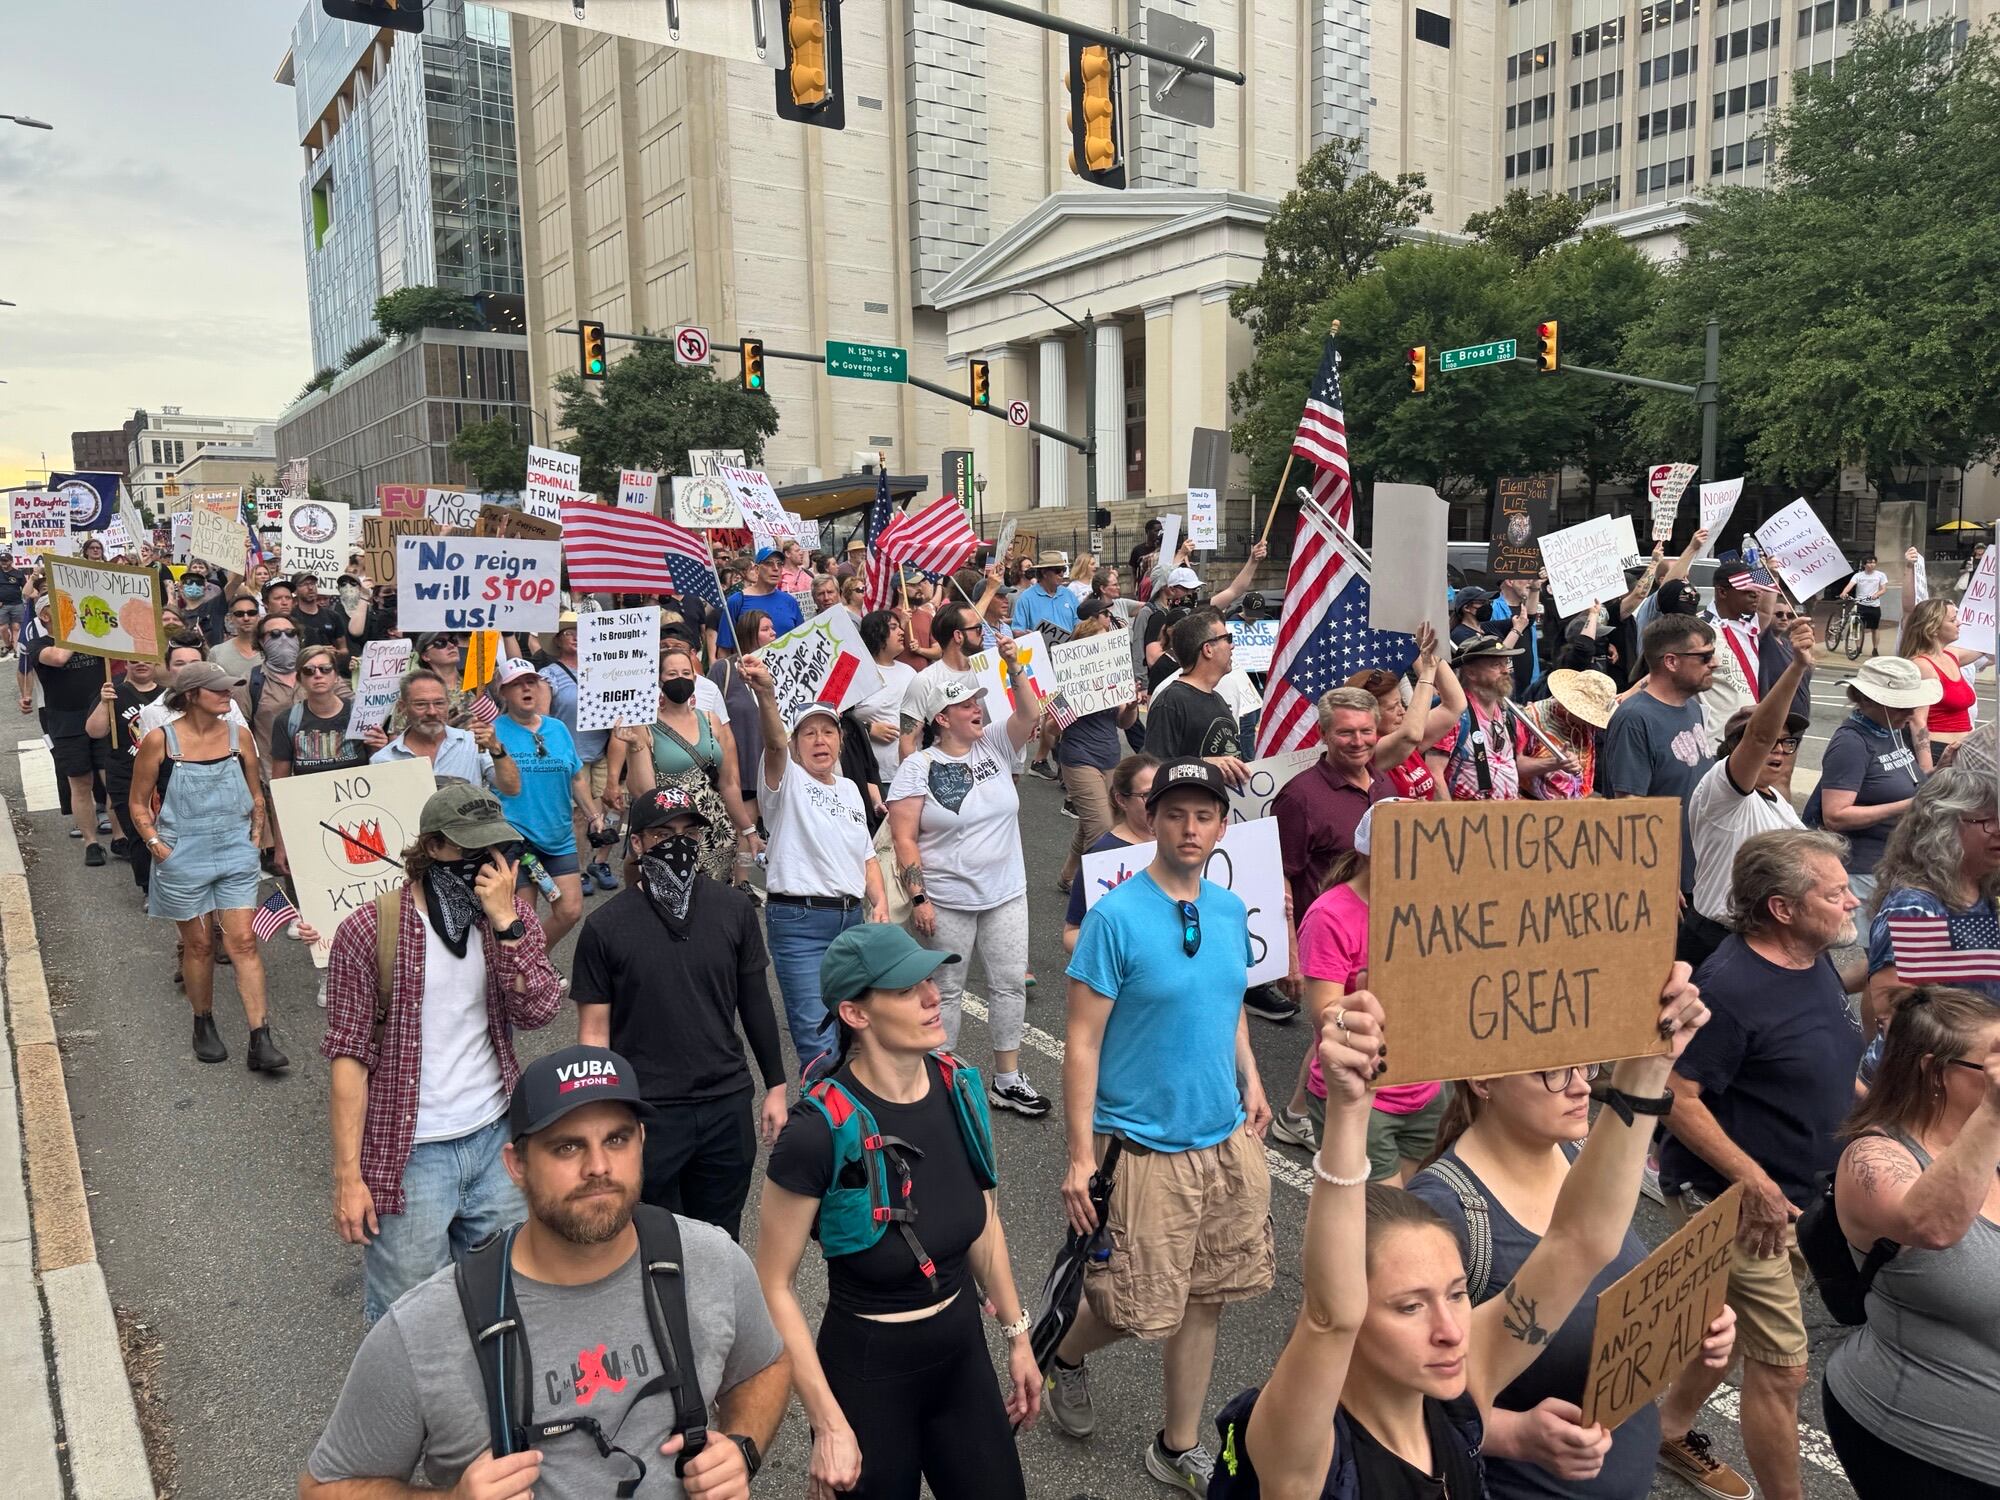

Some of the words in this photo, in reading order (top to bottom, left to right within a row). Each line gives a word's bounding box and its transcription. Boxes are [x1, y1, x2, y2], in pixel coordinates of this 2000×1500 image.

[848, 347, 856, 355] N.
[858, 348, 875, 356] 12th
[877, 350, 887, 358] St
[1446, 354, 1454, 363] E.
[1460, 346, 1493, 360] Broad
[1498, 343, 1511, 353] St
[842, 361, 881, 372] Governor
[883, 365, 893, 374] St
[529, 454, 579, 476] IMPEACH
[956, 456, 965, 475] VCU
[528, 472, 576, 491] CRIMINAL
[623, 473, 652, 487] HELLO
[719, 465, 768, 487] THINK
[1500, 479, 1528, 494] FIGHT
[1532, 480, 1546, 488] FOR
[1528, 488, 1547, 499] YOUR
[438, 493, 464, 507] NO
[1503, 496, 1528, 513] LIFE
[1704, 489, 1739, 506] NOBODY
[198, 510, 222, 531] DHS
[428, 505, 480, 529] KINGS
[1760, 517, 1790, 540] THIS
[1794, 508, 1808, 519] IS
[764, 521, 796, 536] LEGAL
[1547, 528, 1612, 564] IGNORANCE
[1765, 528, 1812, 556] Democracy
[1494, 557, 1516, 570] CAT
[1776, 557, 1791, 571] NO
[1795, 536, 1831, 560] KINGS
[285, 560, 339, 572] ALWAYS
[366, 550, 395, 581] TO
[474, 550, 537, 578] reign
[1787, 573, 1801, 587] NO
[1801, 552, 1836, 577] NAZIS
[52, 563, 100, 592] TRUMP
[102, 571, 150, 597] SMELLS
[414, 575, 471, 600] will
[482, 576, 555, 604] STOP
[1971, 580, 1987, 598] NO
[597, 616, 615, 626] This
[619, 613, 644, 626] SIGN
[1962, 606, 1975, 622] NO
[599, 632, 608, 641] Is
[608, 629, 641, 640] Brought
[1234, 622, 1270, 634] SAVE
[366, 642, 407, 662] Spread
[592, 652, 602, 662] To
[603, 650, 617, 660] You
[618, 649, 629, 659] By
[631, 648, 645, 659] My
[1052, 642, 1100, 665] YORKTOWN
[1107, 633, 1129, 652] HERE
[971, 653, 989, 673] NO
[1055, 666, 1072, 683] WON
[1080, 660, 1105, 677] BATTLE
[1113, 653, 1131, 668] WAR
[360, 679, 391, 694] Spread
[602, 689, 637, 703] RIGHT
[1067, 677, 1090, 697] GEORGE
[1092, 675, 1104, 690] NOT
[1073, 693, 1096, 716] NO
[1101, 682, 1136, 708] KINGS
[353, 706, 386, 720] Spread
[355, 720, 377, 732] Hop
[1210, 732, 1223, 754] ONLY
[975, 765, 1000, 781] WALZ
[334, 776, 371, 802] NO
[1393, 812, 1664, 880] IMMIGRANTS
[1384, 901, 1507, 962] MAKE
[1517, 889, 1651, 948] AMERICA
[1469, 968, 1600, 1041] GREAT
[556, 1060, 617, 1083] VUBA
[574, 1077, 608, 1089] STONE
[1622, 1213, 1724, 1319] LIBERTY
[1596, 1322, 1643, 1372] AND
[1648, 1239, 1735, 1330] JUSTICE
[1592, 1341, 1652, 1424] FOR
[1658, 1287, 1712, 1381] ALL
